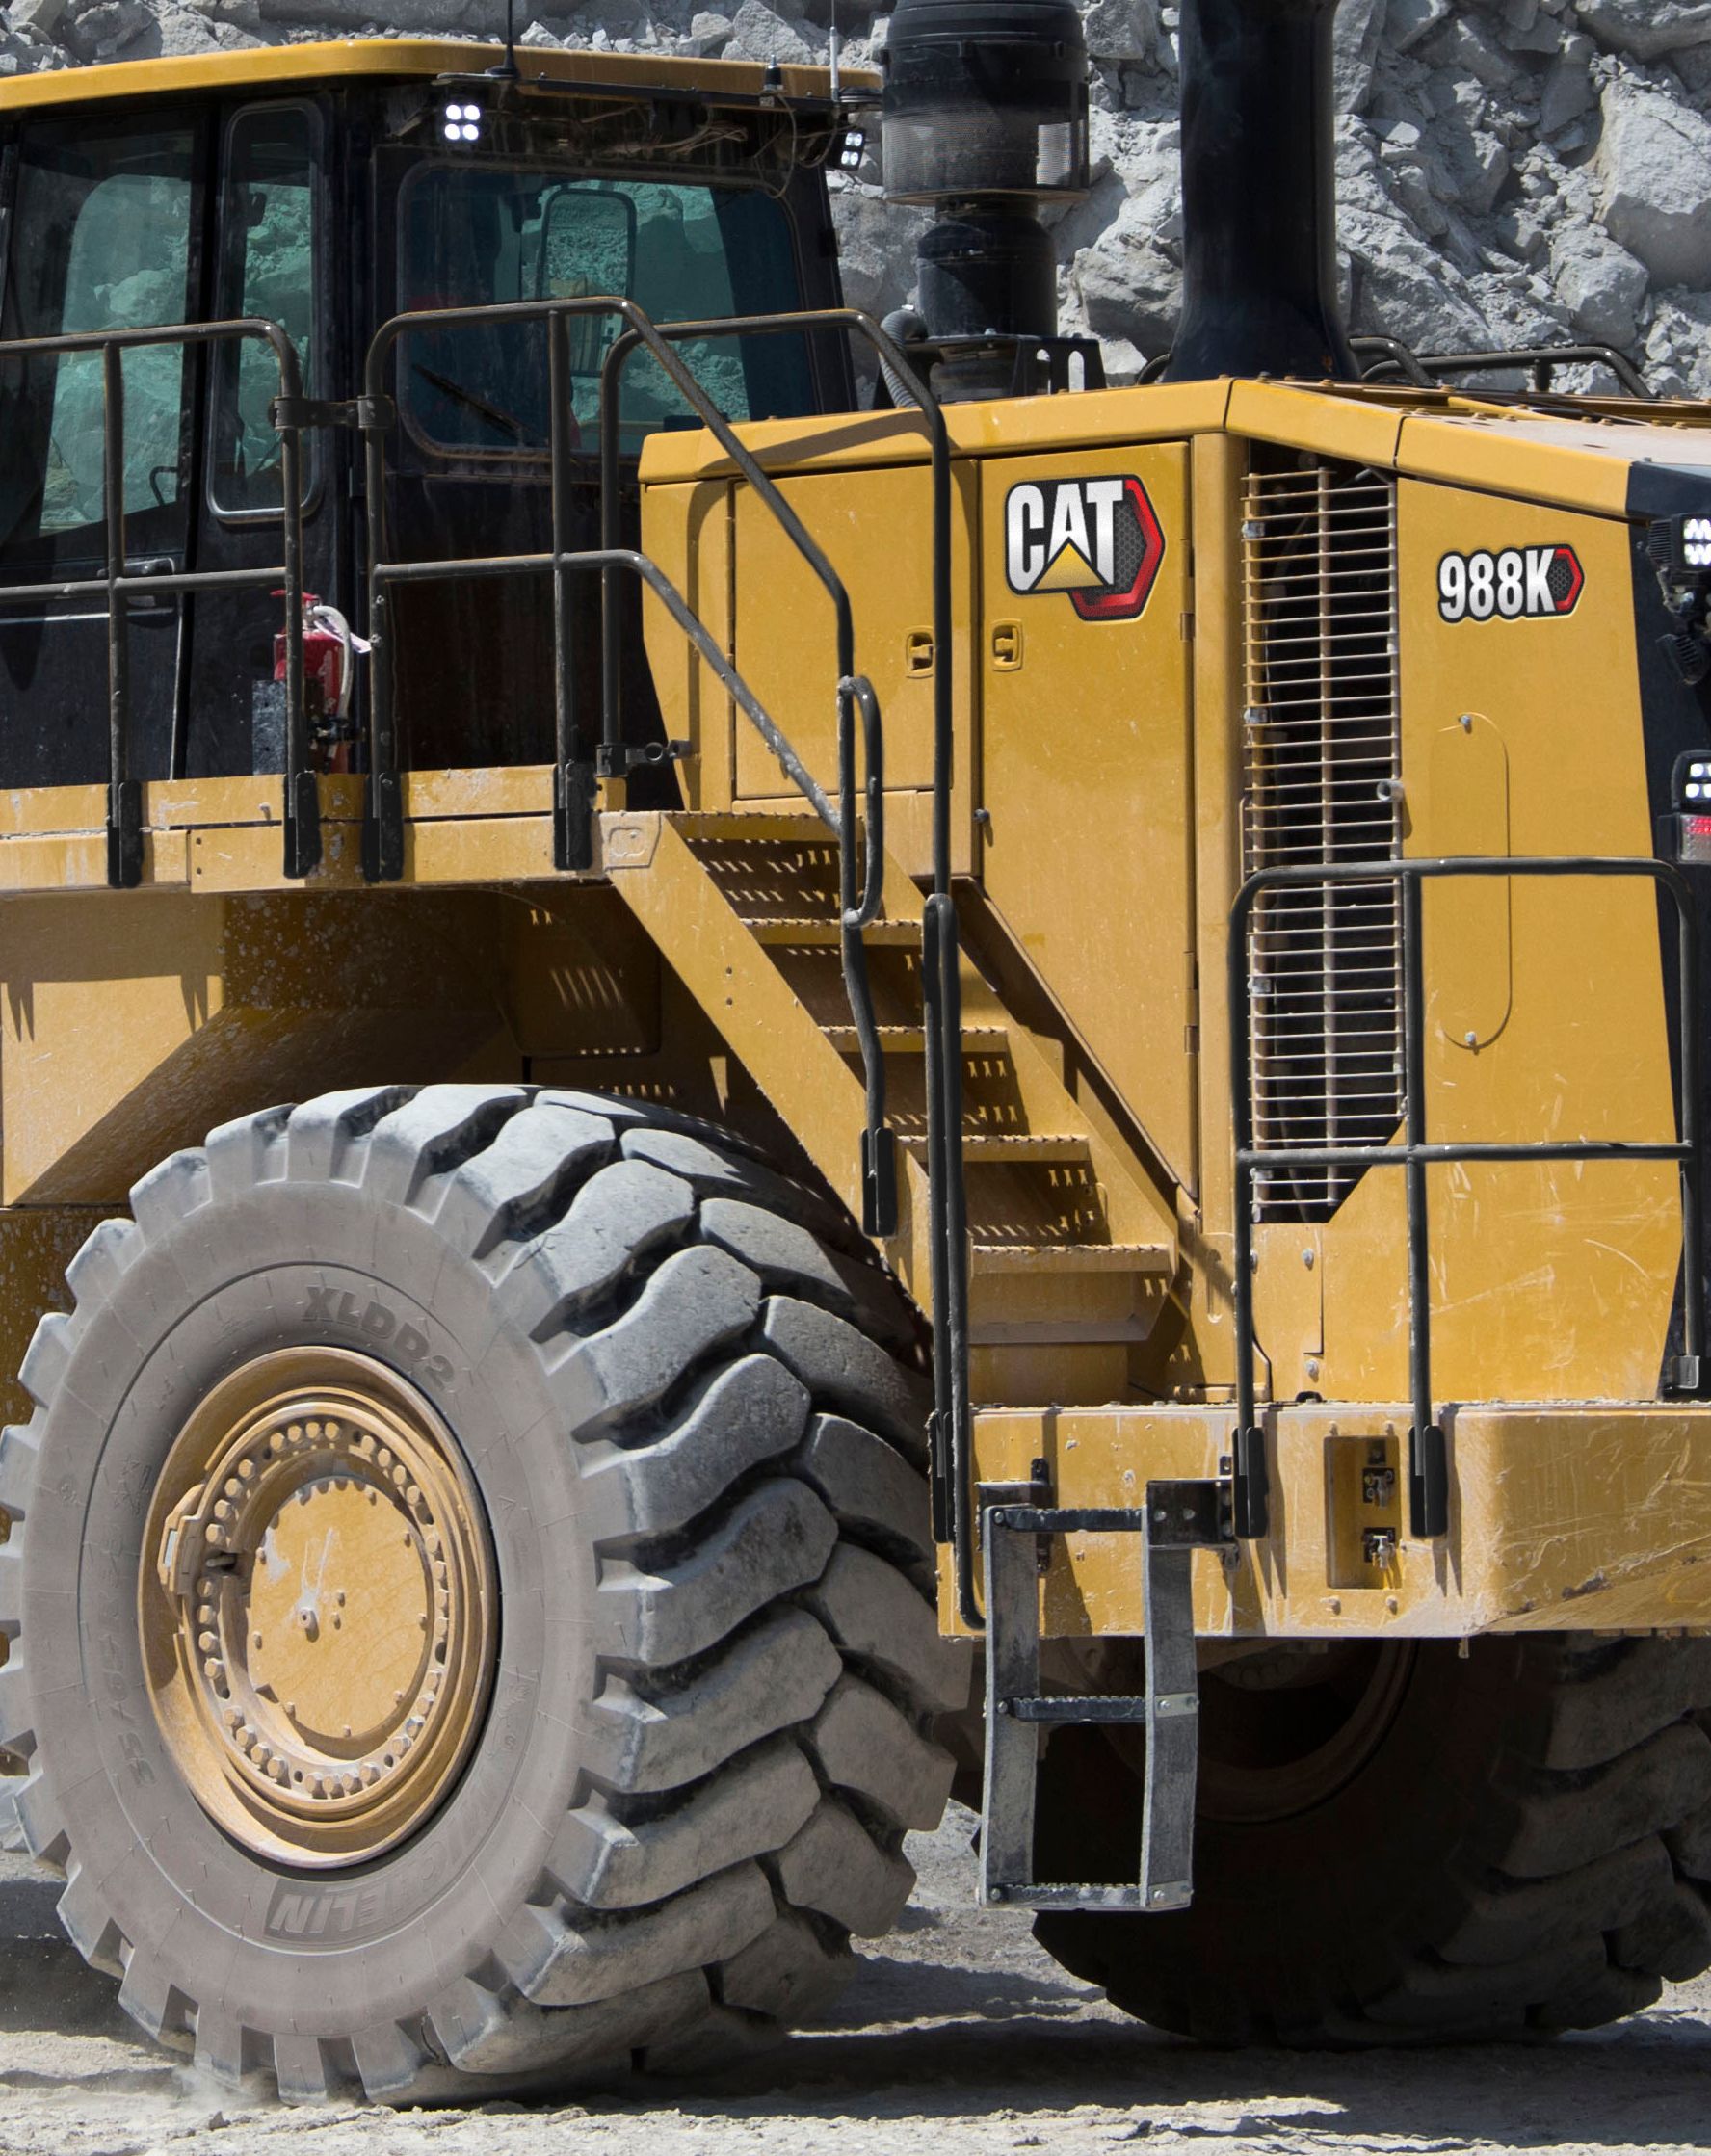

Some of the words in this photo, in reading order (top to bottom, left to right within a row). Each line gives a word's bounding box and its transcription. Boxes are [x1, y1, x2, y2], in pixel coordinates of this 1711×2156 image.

[1008, 481, 1123, 591] CAT
[1439, 547, 1556, 617] 988K
[301, 1285, 455, 1391] XLDD2
